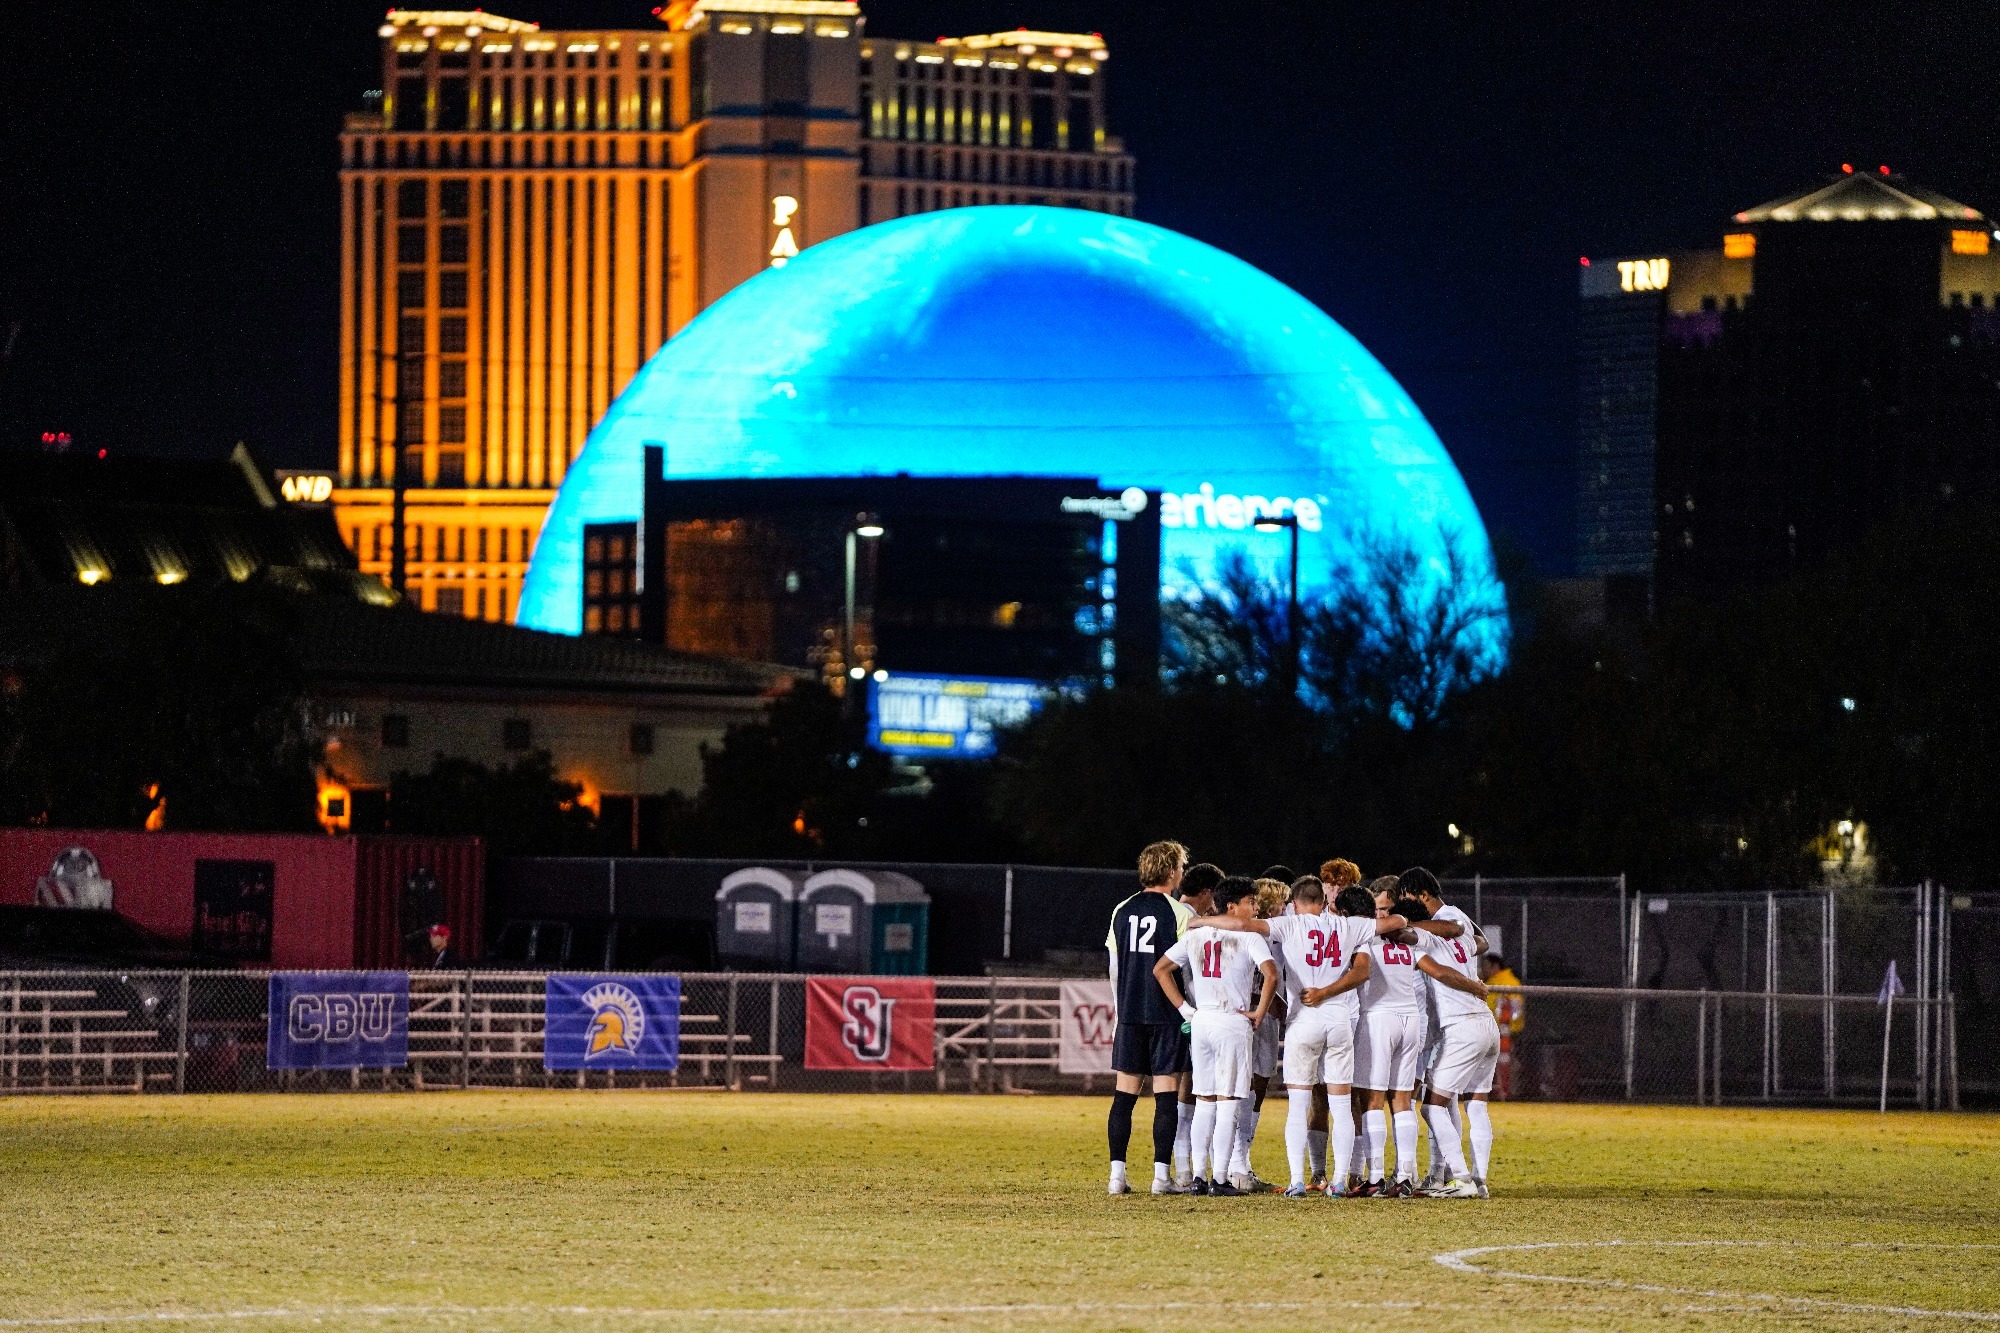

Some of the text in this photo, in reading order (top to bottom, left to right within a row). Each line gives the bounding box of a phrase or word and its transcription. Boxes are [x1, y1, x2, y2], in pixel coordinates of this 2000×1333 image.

[770, 196, 799, 269] PA
[1617, 258, 1670, 292] TRU
[1129, 915, 1157, 953] 12
[1305, 930, 1341, 967] 34
[1202, 941, 1222, 978] 11
[289, 993, 395, 1042] CBU
